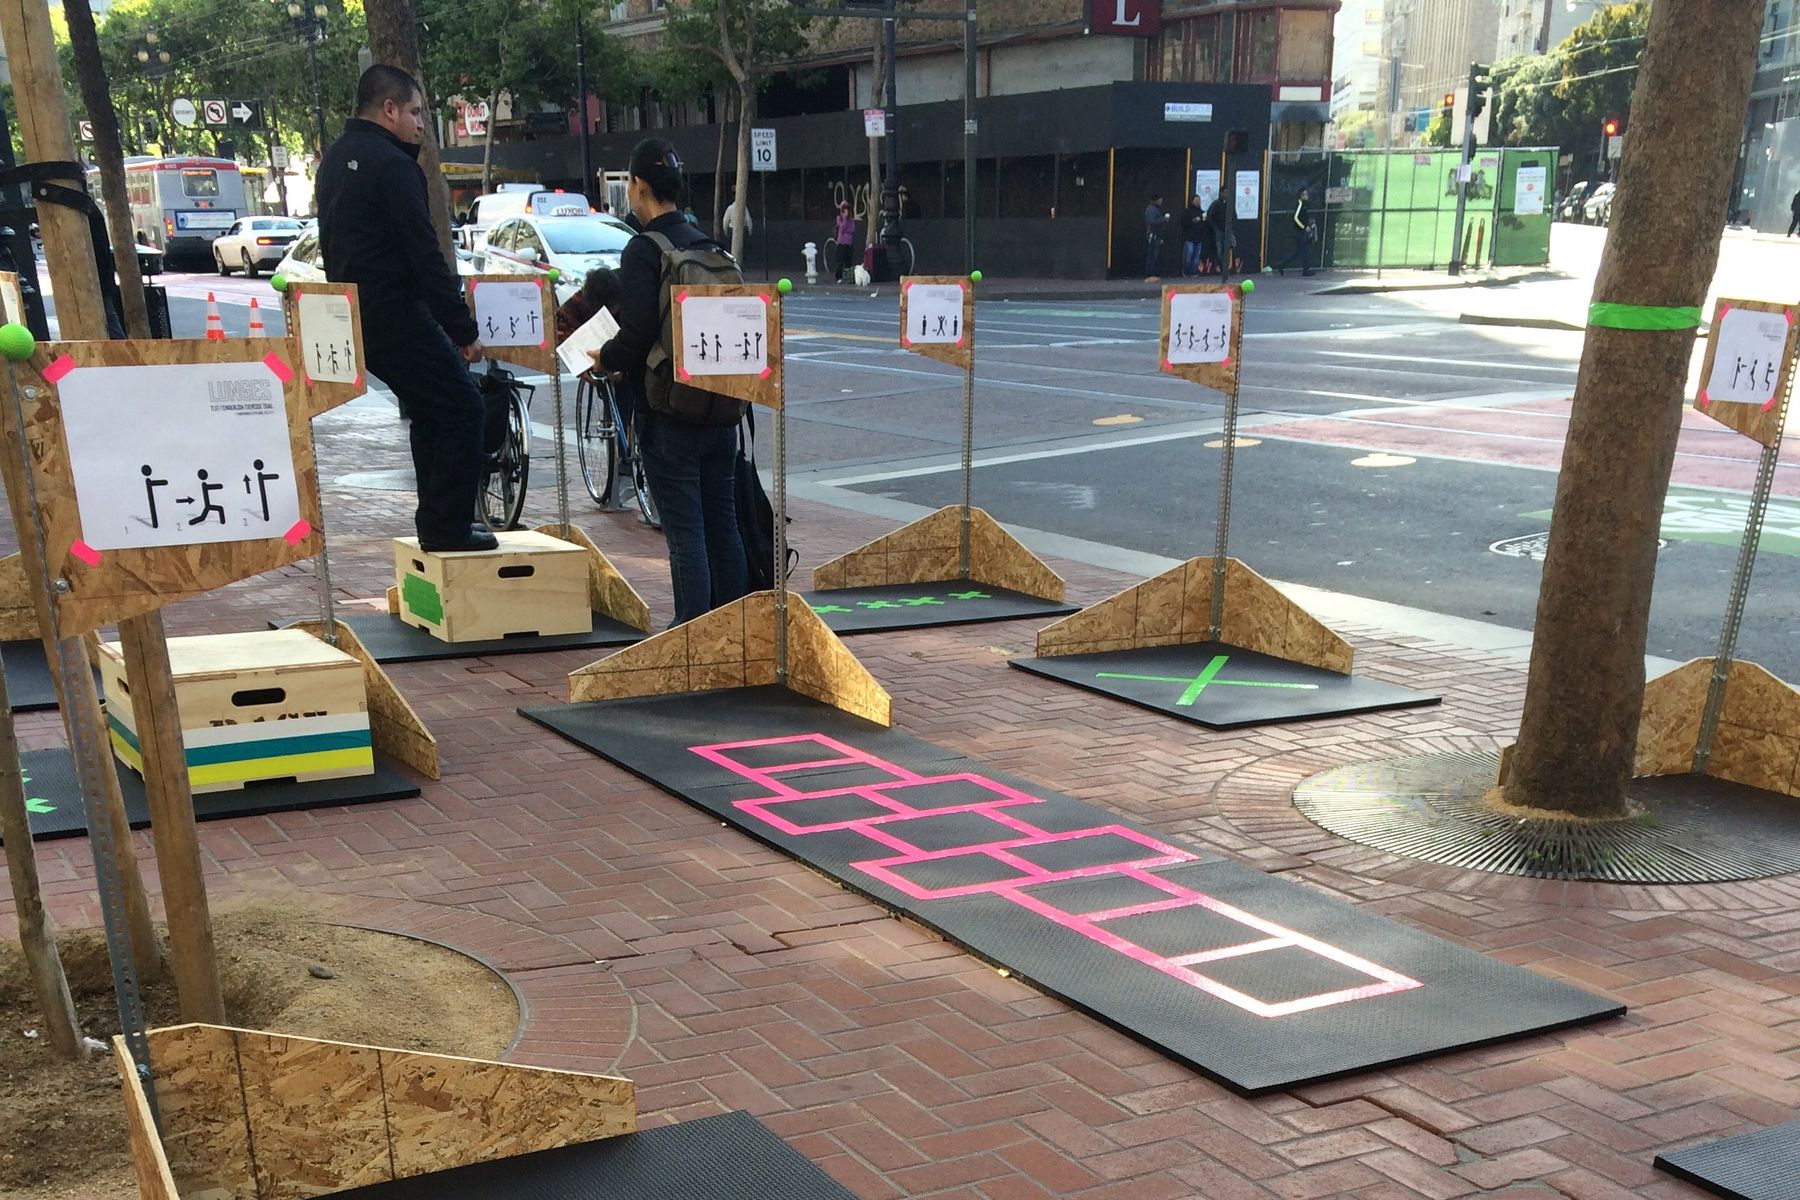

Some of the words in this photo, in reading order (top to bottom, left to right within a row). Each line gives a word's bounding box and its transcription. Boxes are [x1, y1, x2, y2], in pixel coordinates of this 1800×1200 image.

[757, 149, 771, 162] 10
[556, 207, 584, 216] LUXOR
[208, 379, 272, 402] LUNGES
